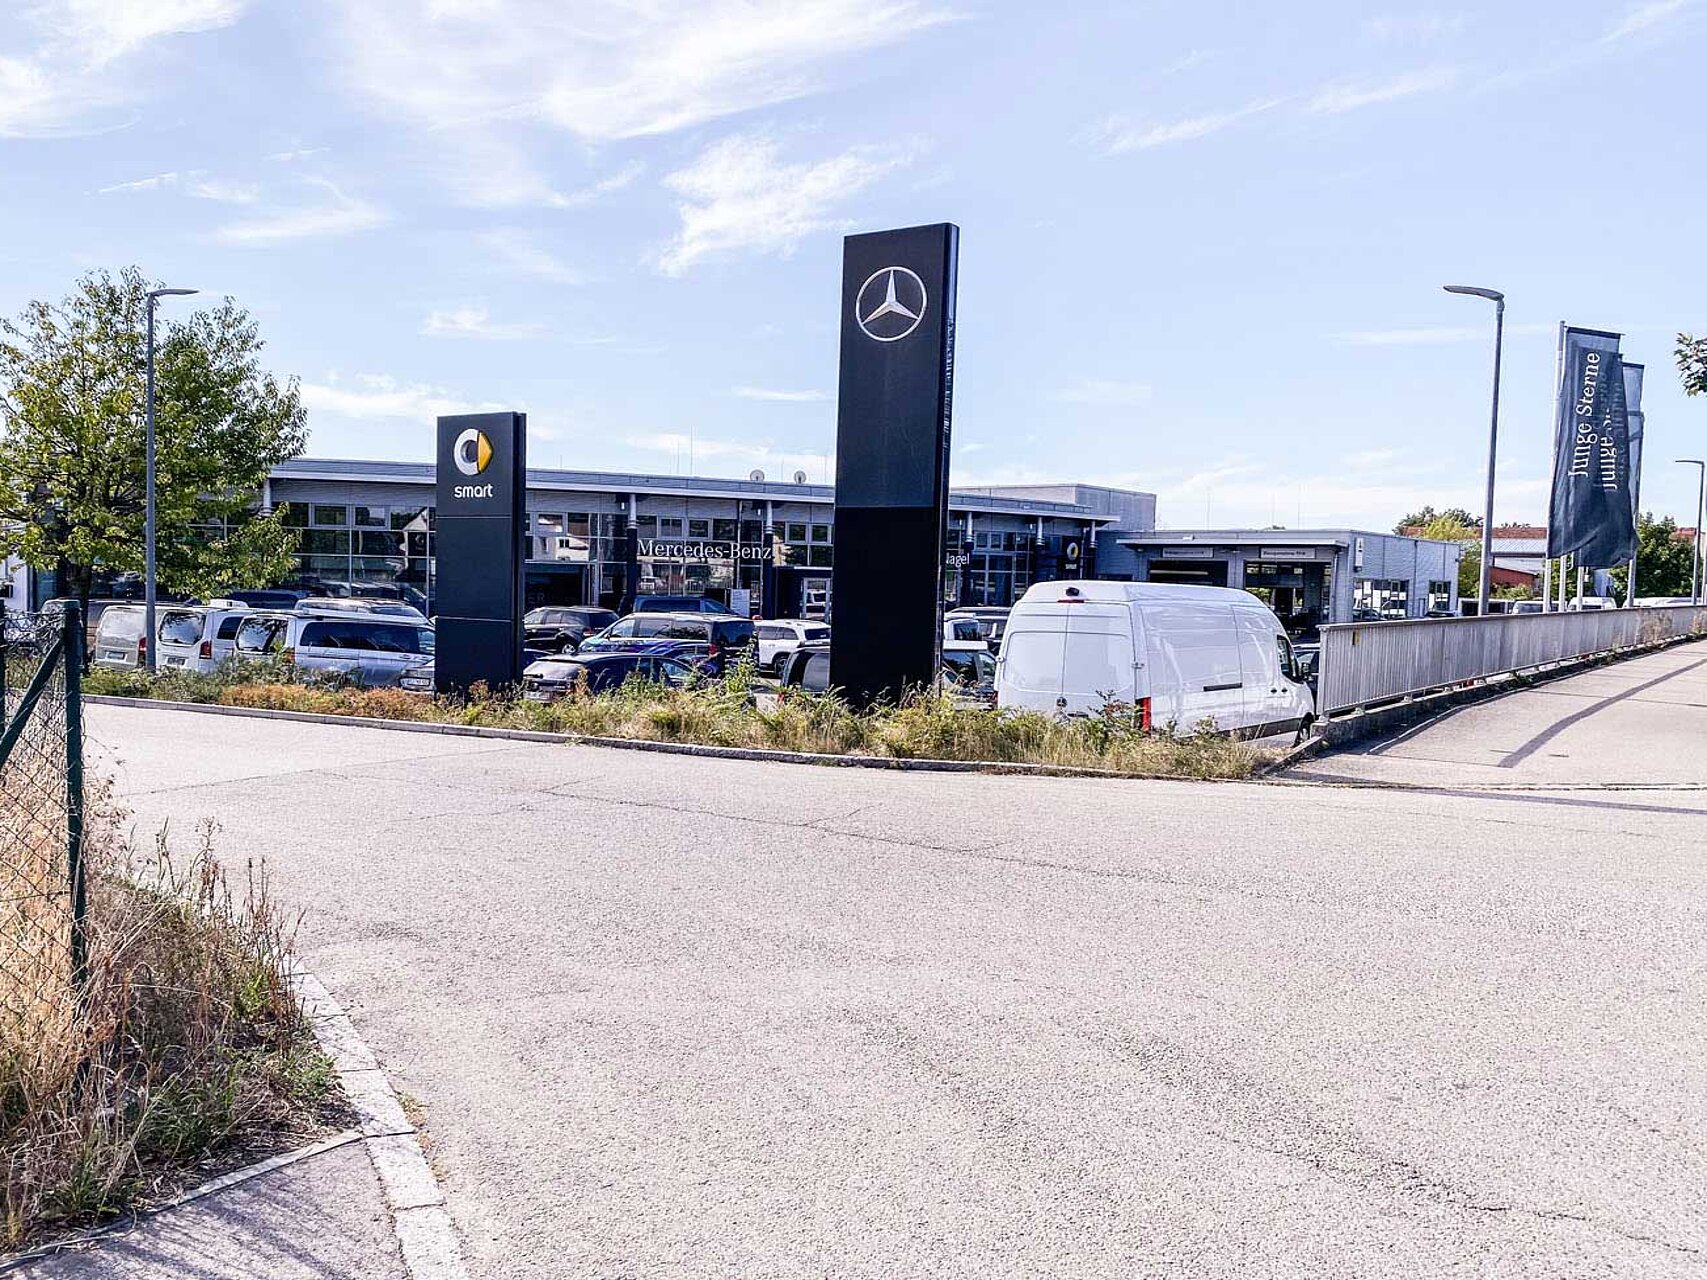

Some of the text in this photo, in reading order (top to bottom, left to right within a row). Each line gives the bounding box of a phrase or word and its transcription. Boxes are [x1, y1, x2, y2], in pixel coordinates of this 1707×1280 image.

[1567, 352, 1600, 478] Junge Sterne
[454, 483, 494, 498] smart
[637, 539, 772, 559] Mercedes-Benz
